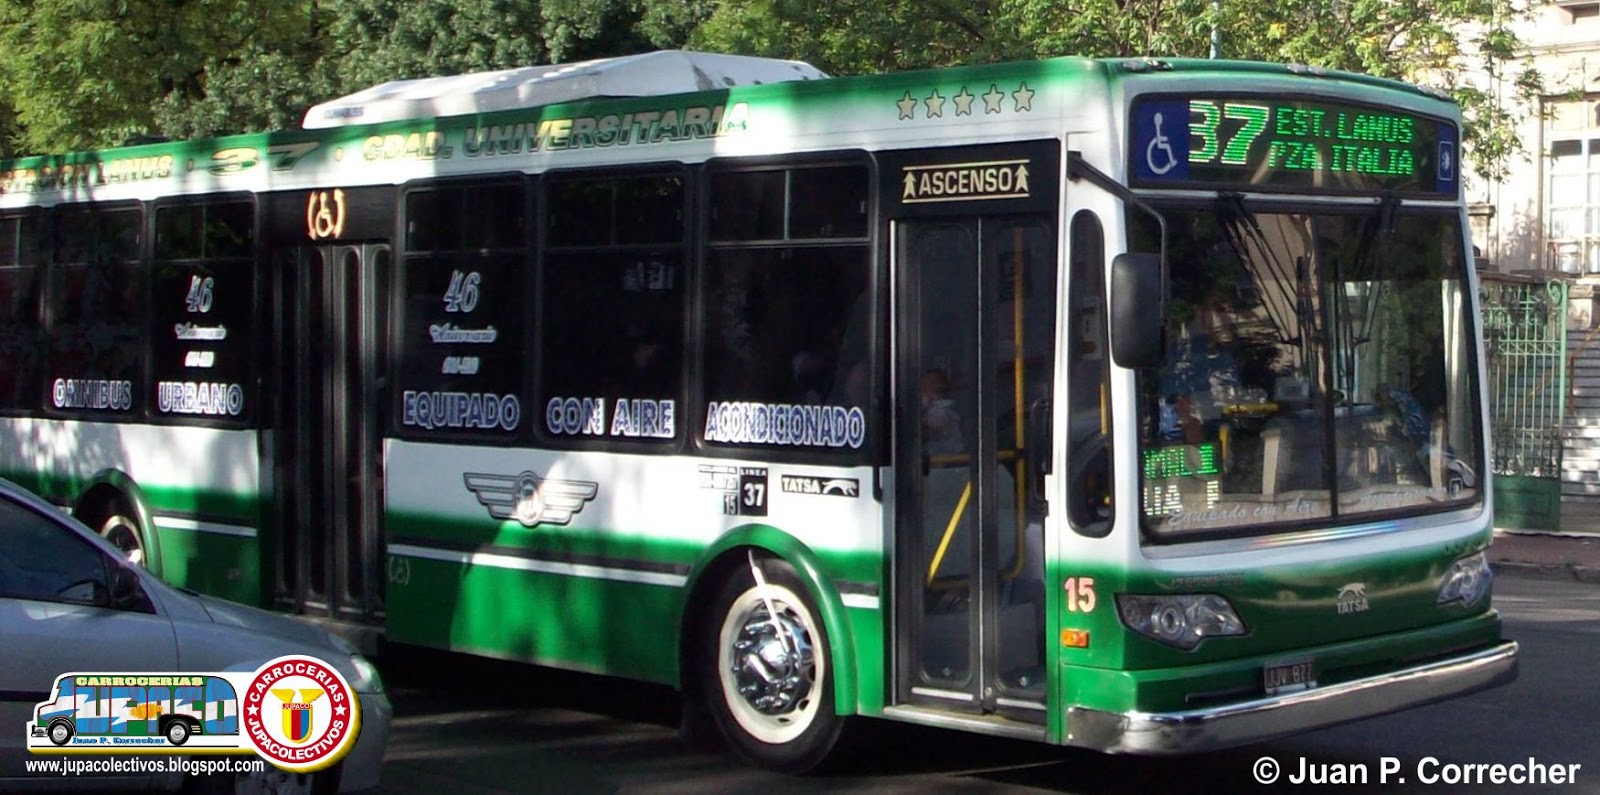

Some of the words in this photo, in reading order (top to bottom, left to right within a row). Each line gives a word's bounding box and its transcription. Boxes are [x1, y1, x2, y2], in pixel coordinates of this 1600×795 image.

[207, 141, 320, 176] 37
[462, 102, 751, 158] UNIVERSITARIA
[1188, 100, 1270, 165] 37
[1275, 107, 1332, 138] EST.
[1337, 112, 1413, 144] LANUS
[1330, 144, 1414, 175] ITALIA
[918, 166, 1013, 196] ASCENSO
[185, 275, 214, 313] 46
[443, 269, 481, 313] 46
[53, 378, 132, 410] OMNIBUS
[158, 382, 243, 415] URBANO
[403, 391, 520, 431] EQUIPADO
[546, 397, 605, 436] CON
[610, 398, 676, 438] AIRE
[704, 401, 865, 449] ACONDICIONADO
[744, 483, 765, 507] 37
[781, 477, 821, 494] TATSA
[725, 494, 736, 516] 15
[1064, 577, 1096, 613] 15
[1336, 599, 1368, 614] TATSA
